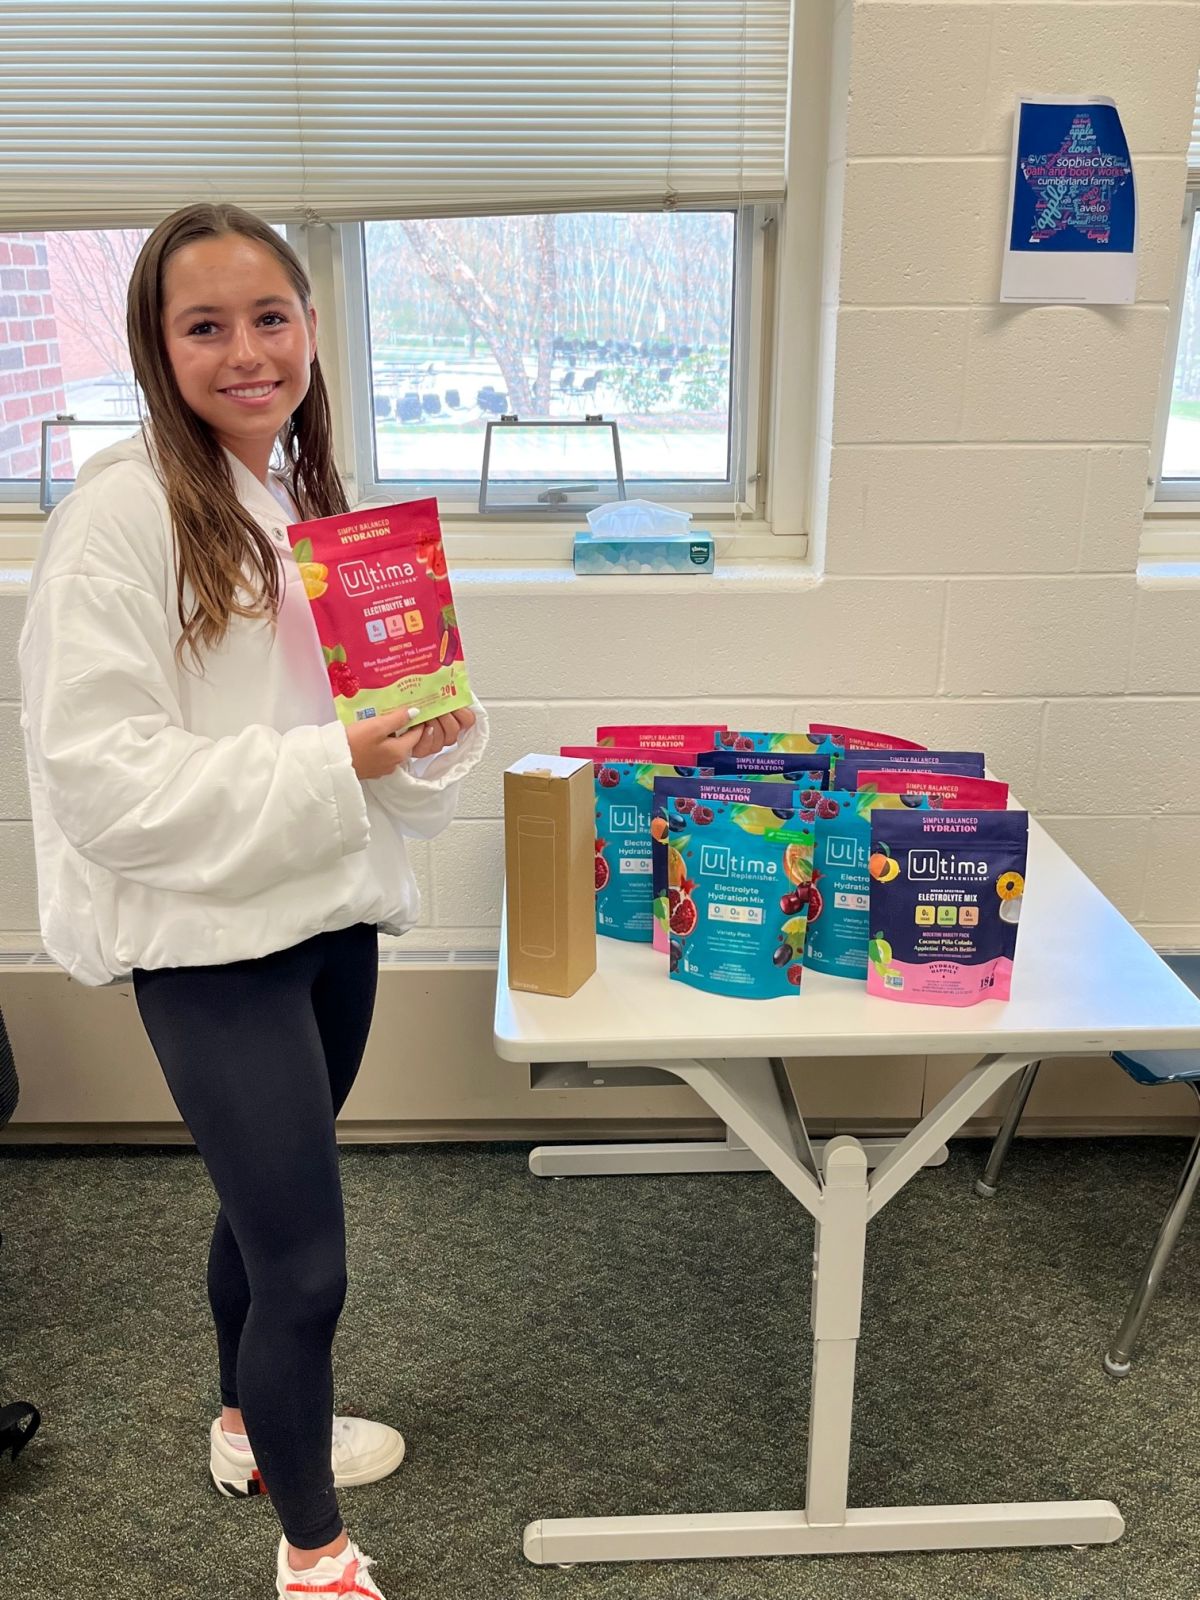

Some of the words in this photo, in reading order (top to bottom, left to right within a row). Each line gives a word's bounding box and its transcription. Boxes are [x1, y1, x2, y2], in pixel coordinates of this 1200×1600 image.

[1068, 140, 1092, 153] dove
[1049, 167, 1066, 176] and
[1069, 167, 1094, 179] body
[1037, 177, 1088, 185] cumberland
[1090, 177, 1115, 185] farms
[1080, 204, 1106, 213] avelo
[337, 524, 359, 536] SIMPLY
[359, 518, 390, 531] BALANCED
[341, 527, 391, 544] HYDRATION
[342, 561, 415, 591] Ultima
[363, 600, 404, 617] ELECTROLYTE
[403, 597, 416, 608] MIX
[440, 685, 450, 697] 20
[866, 741, 893, 749] BALANCED
[721, 786, 752, 794] BALANCED
[927, 784, 959, 792] BALANCED
[700, 793, 750, 801] HYDRATION
[613, 811, 652, 828] Ulti
[945, 817, 978, 825] BALANCED
[923, 825, 977, 833] HYDRATION
[624, 840, 652, 848] Electro
[830, 842, 871, 862] Ulti
[704, 852, 777, 874] Ultima
[912, 854, 988, 875] Ultima
[840, 873, 870, 883] Electro
[714, 884, 759, 895] Electrolyte
[707, 893, 748, 904] Hydration
[749, 895, 764, 904] Mix
[918, 893, 962, 902] ELECTROLYTE
[964, 894, 978, 902] MIX
[913, 945, 939, 953] Appletini
[689, 964, 698, 973] 20
[929, 963, 959, 971] HYDRATE
